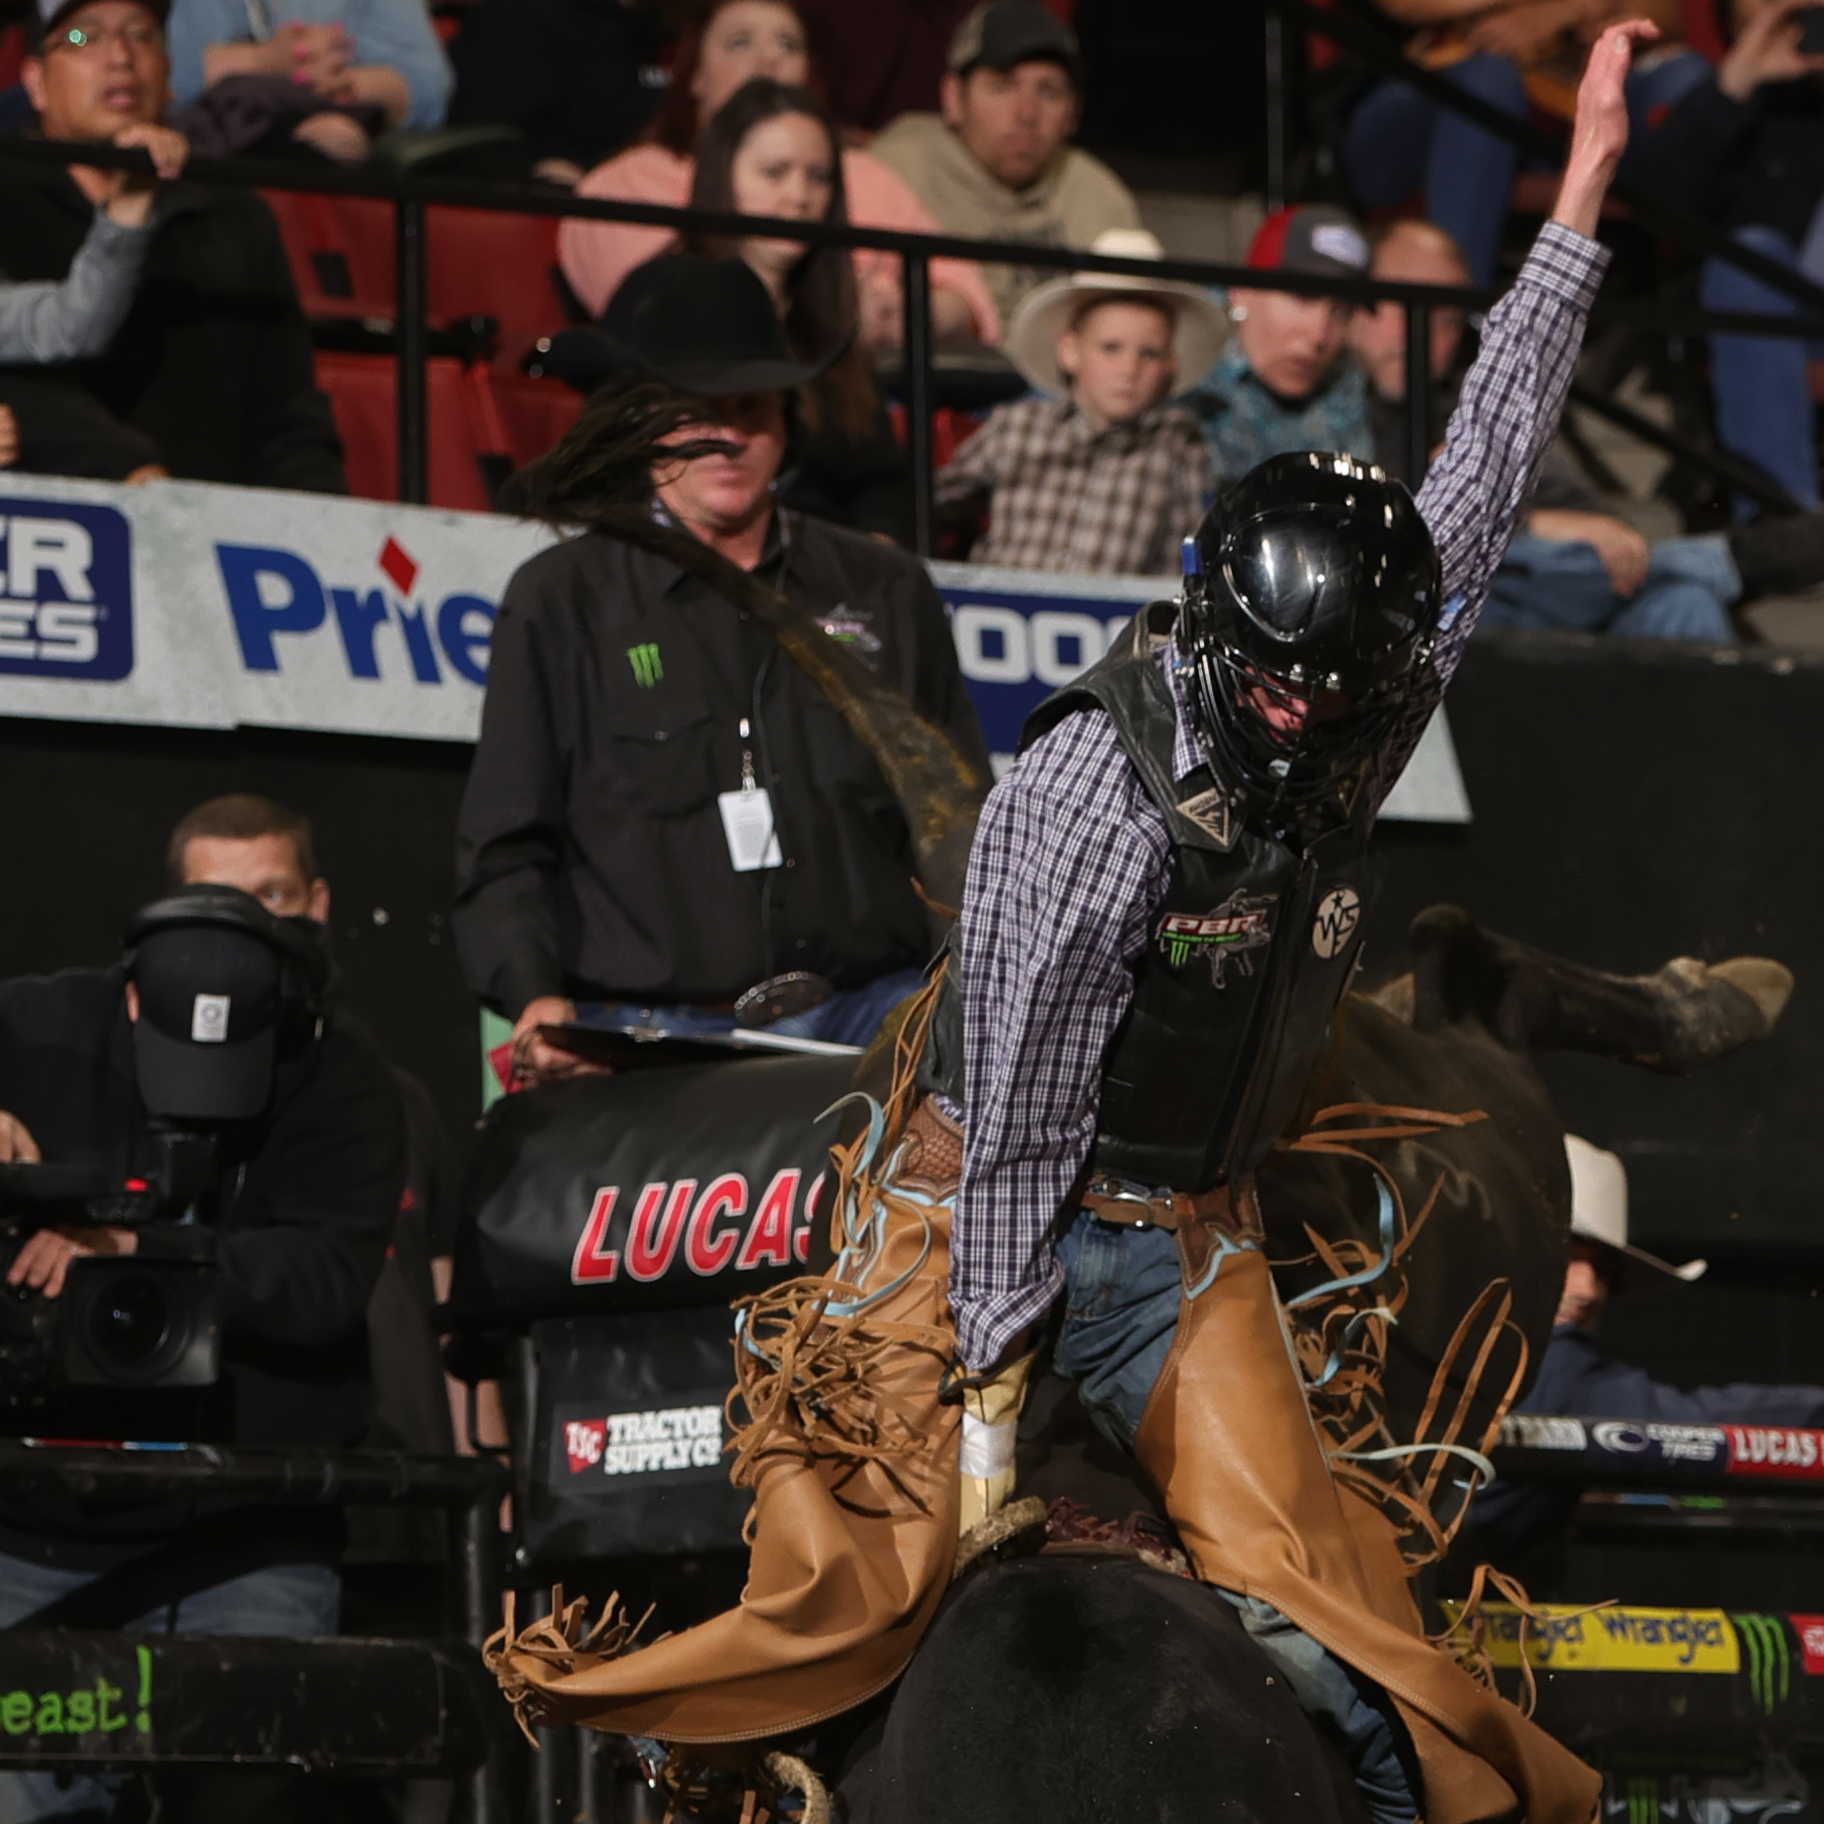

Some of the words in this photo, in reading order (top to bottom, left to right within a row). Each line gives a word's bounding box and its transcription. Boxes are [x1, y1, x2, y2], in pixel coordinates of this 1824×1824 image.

[607, 1405, 722, 1444] TRACTOR
[604, 1439, 691, 1475] SUPPLY
[1734, 1429, 1816, 1467] LUCAS
[1596, 1612, 1724, 1664] Wrangler
